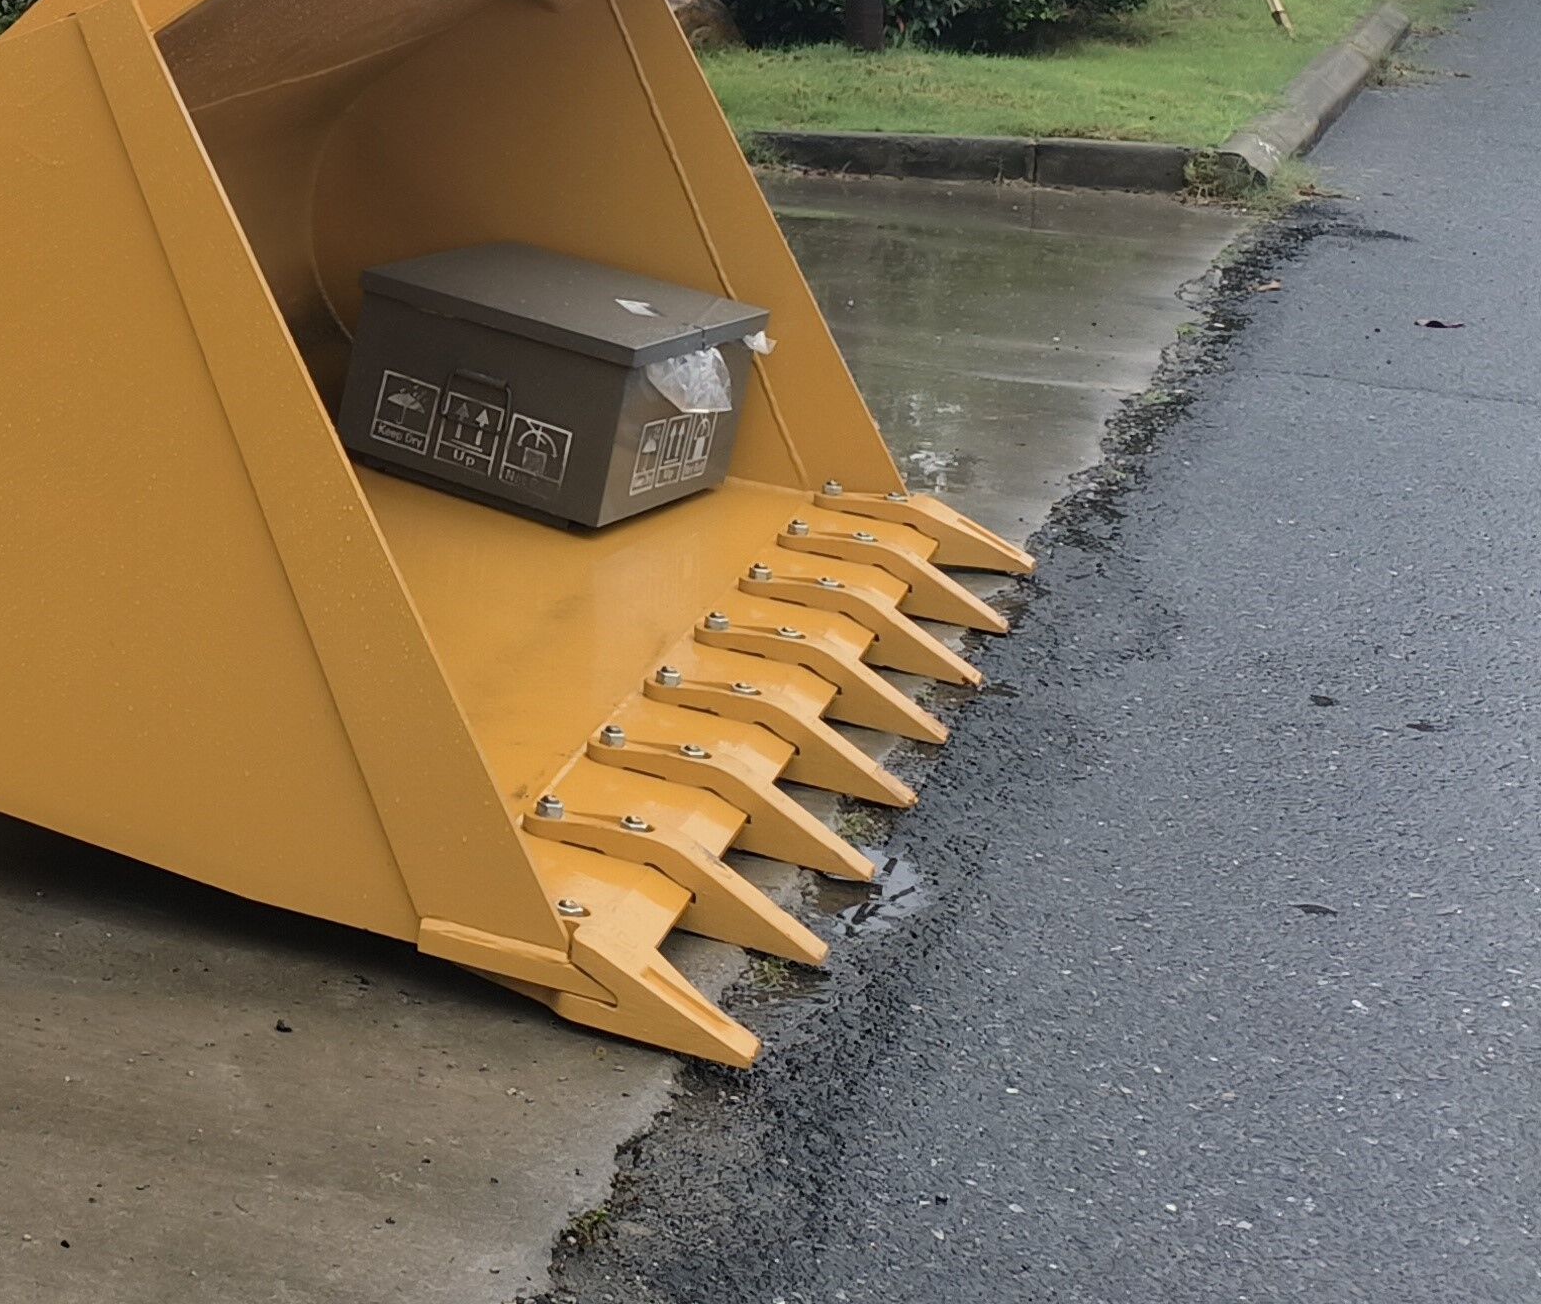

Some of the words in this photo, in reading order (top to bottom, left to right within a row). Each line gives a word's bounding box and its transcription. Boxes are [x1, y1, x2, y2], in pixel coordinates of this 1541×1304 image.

[378, 424, 403, 443] Keep
[405, 431, 423, 450] Dry
[452, 449, 476, 467] Up
